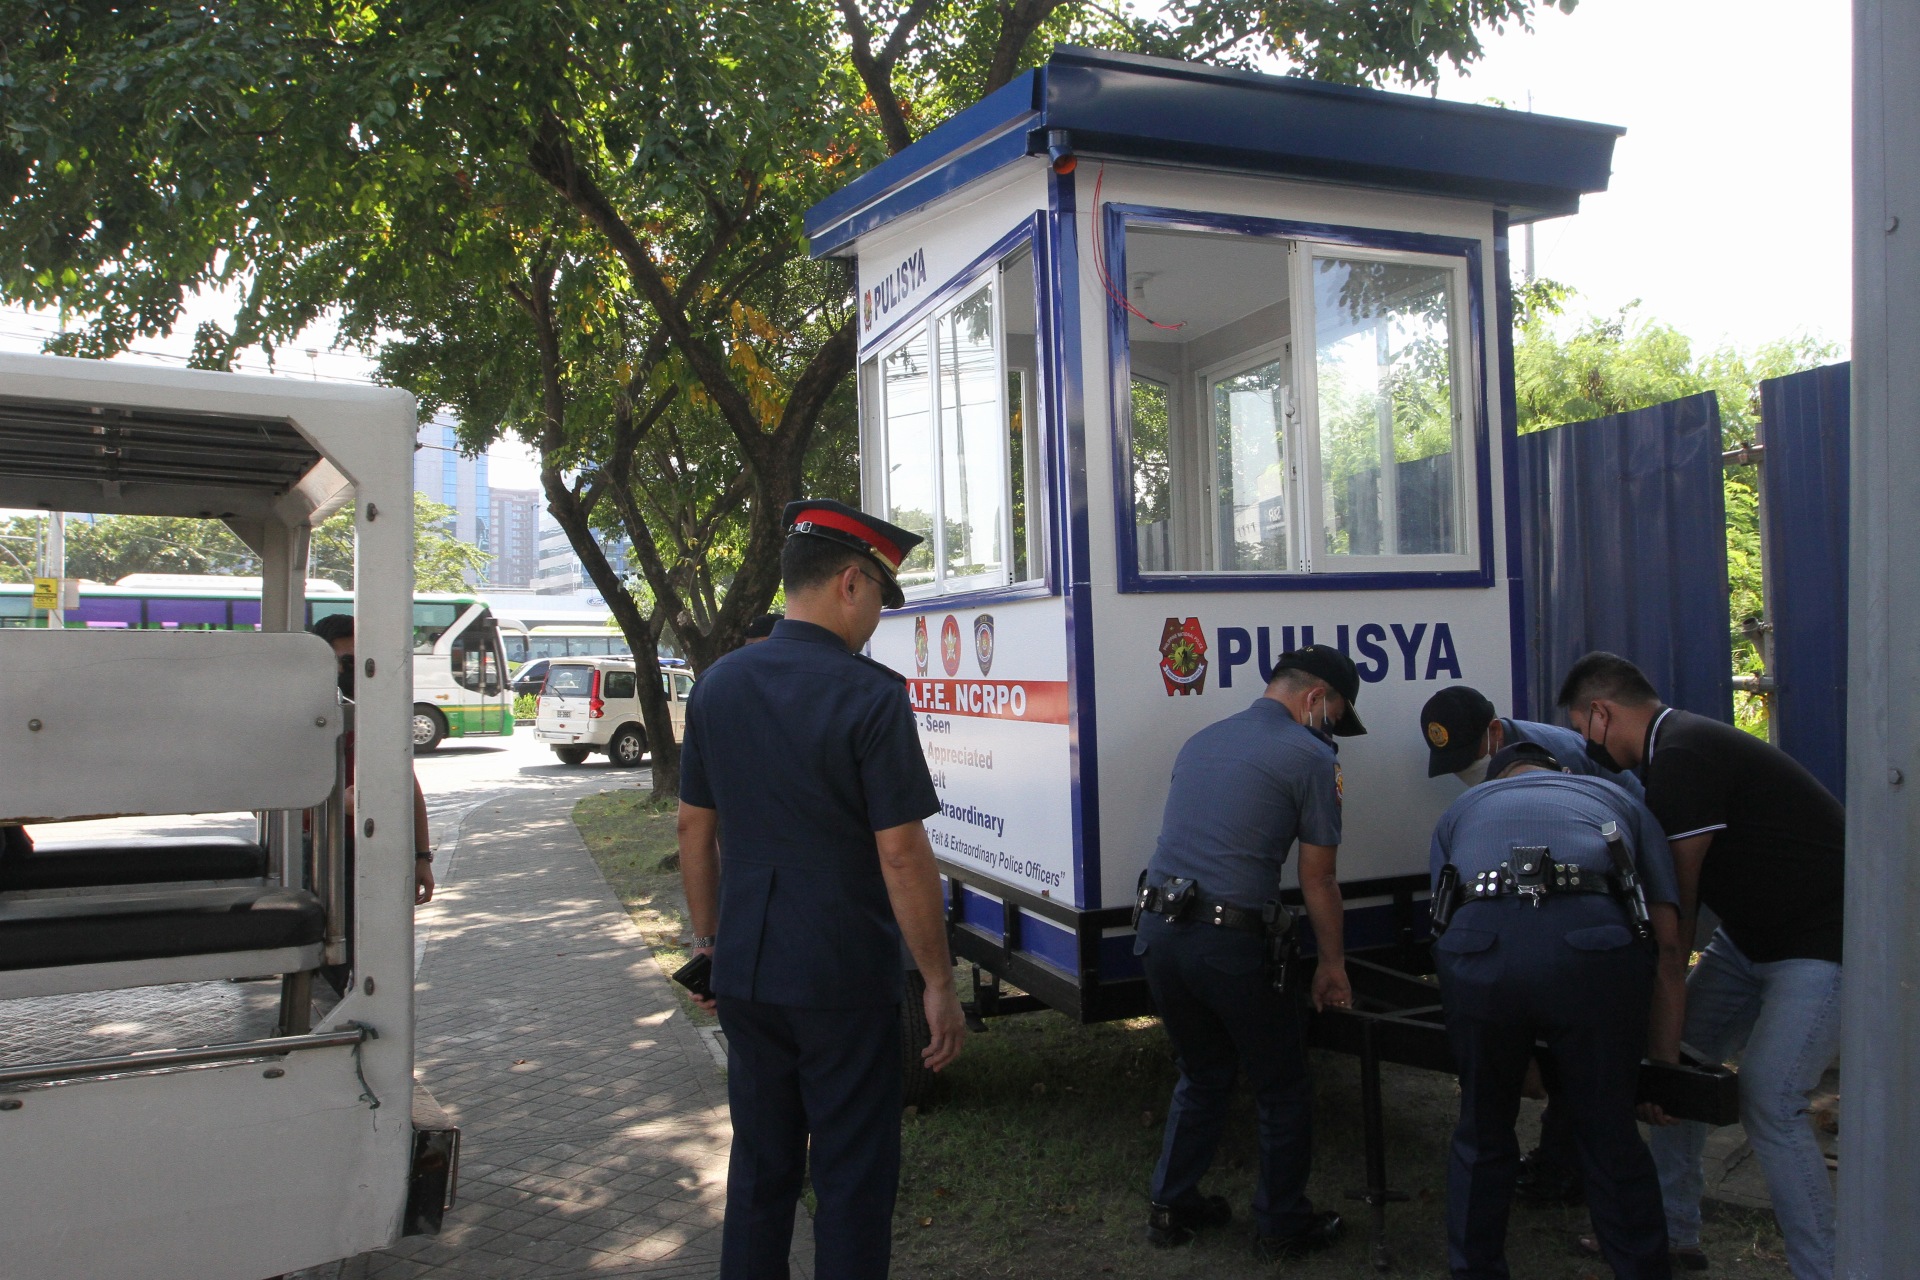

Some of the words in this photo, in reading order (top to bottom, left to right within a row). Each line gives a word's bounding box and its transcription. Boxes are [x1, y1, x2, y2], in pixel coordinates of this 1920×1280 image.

[874, 247, 927, 321] PULISYA
[909, 682, 950, 710] A.F.E.
[955, 683, 1027, 717] NCRPO
[926, 714, 951, 734] Seen
[927, 741, 993, 770] Appreciated
[929, 768, 946, 789] elt
[937, 798, 1005, 838] traordinary
[931, 828, 944, 847] Felt
[943, 833, 950, 848] &
[950, 836, 997, 868] Extraordinary
[999, 851, 1023, 875] Police
